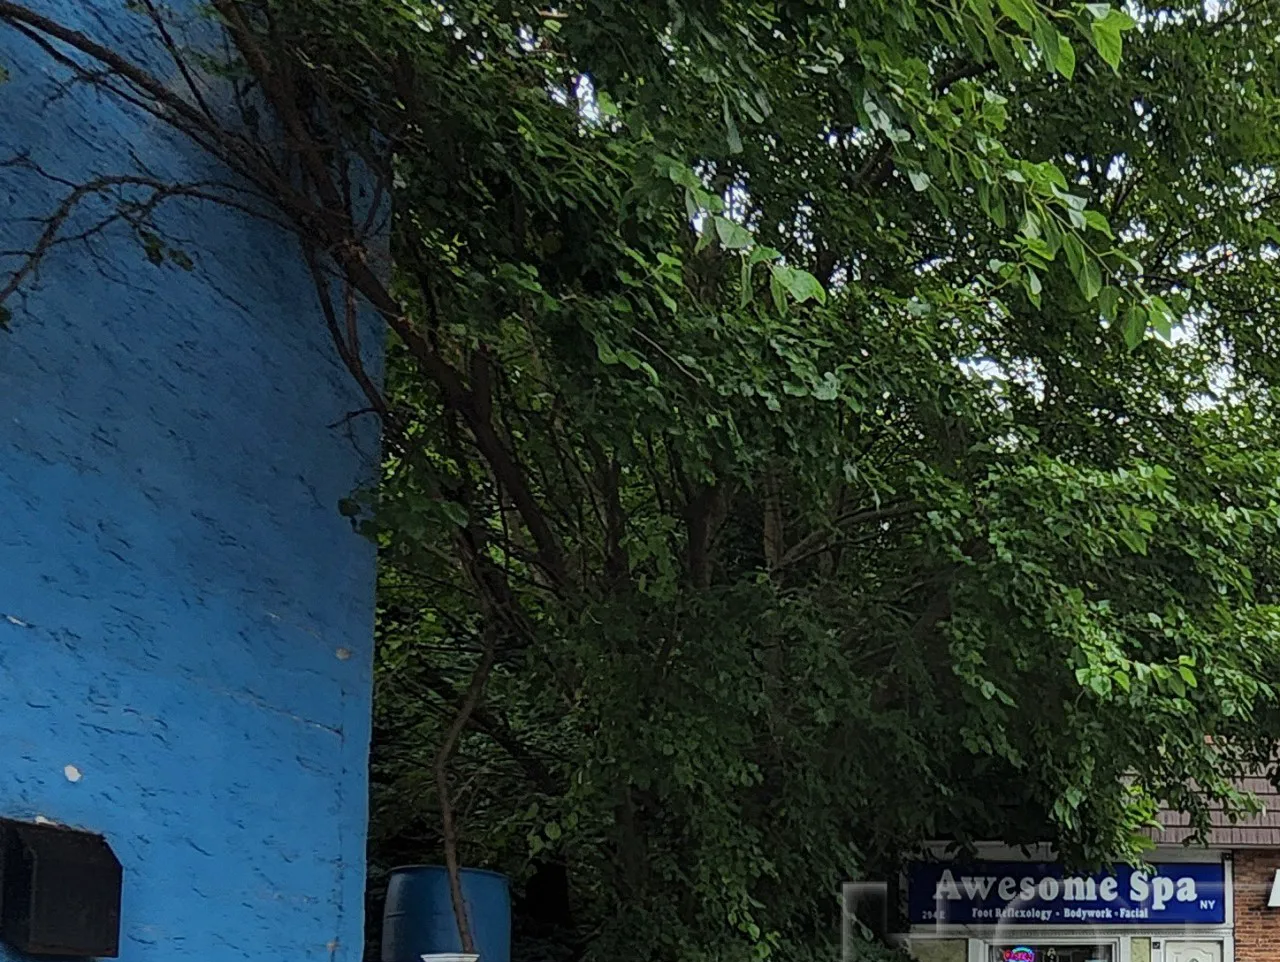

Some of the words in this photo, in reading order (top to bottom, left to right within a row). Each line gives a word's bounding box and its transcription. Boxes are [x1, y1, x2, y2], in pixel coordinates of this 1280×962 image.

[933, 869, 1118, 902] Awesome
[1128, 870, 1198, 910] Spa
[1199, 899, 1216, 910] NY
[972, 908, 993, 919] Foot
[995, 907, 1053, 921] Reflexology
[1064, 907, 1113, 920] Bodywork
[1120, 907, 1149, 919] Facial
